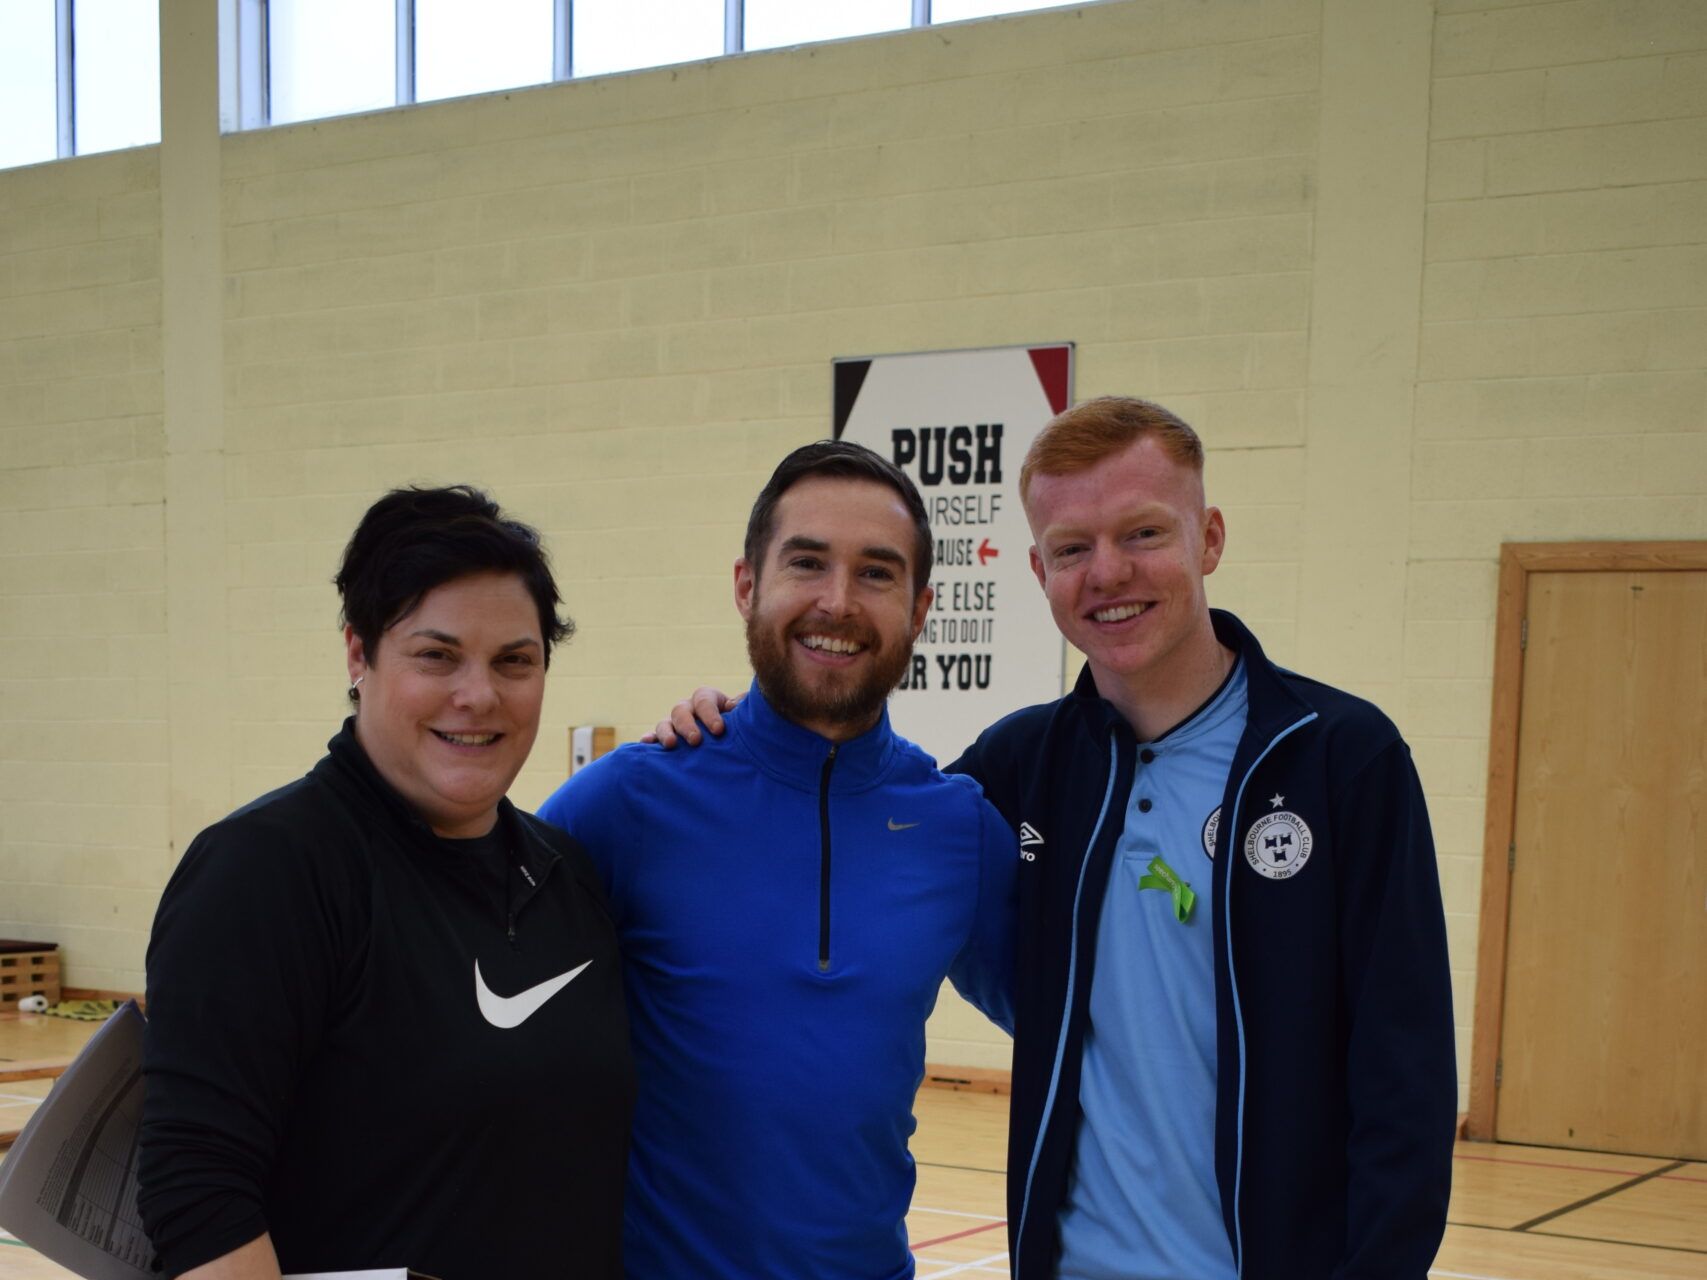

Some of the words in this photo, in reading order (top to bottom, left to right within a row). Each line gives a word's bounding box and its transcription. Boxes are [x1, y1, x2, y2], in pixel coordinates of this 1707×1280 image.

[891, 423, 1004, 486] PUSH
[933, 538, 973, 566] AUSE
[953, 581, 996, 612] ELSE
[940, 618, 957, 644] TO
[960, 618, 978, 643] DO
[981, 617, 995, 643] IT
[936, 653, 992, 691] YOU
[1247, 816, 1272, 866] SHELBOURNE
[1273, 813, 1307, 837] FOOTBALL
[1300, 836, 1310, 860] CLUB
[1272, 868, 1292, 878] 1895
